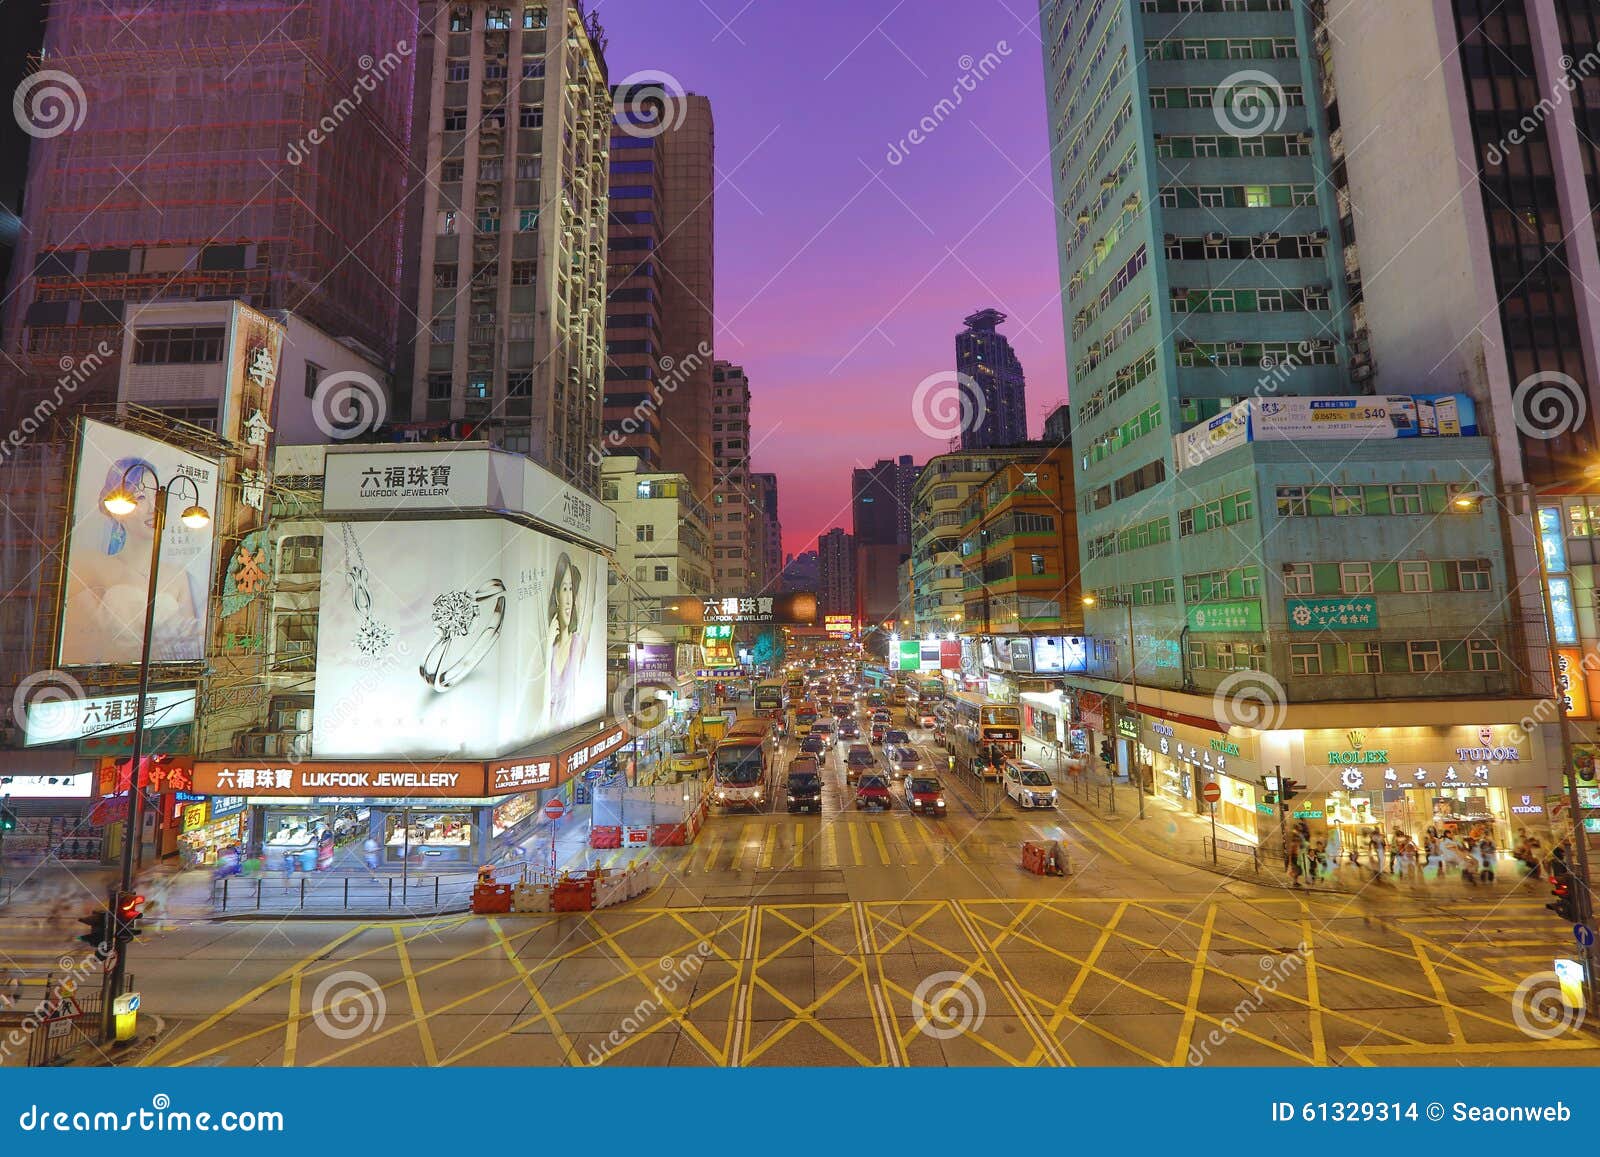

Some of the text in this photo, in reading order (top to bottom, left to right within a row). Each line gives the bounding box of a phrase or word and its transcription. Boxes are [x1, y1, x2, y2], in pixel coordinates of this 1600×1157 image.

[360, 465, 451, 488] 六福珠寶
[360, 487, 450, 498] LUKFOOK JEWELLERY
[703, 597, 774, 615] 六福珠寶
[83, 697, 158, 725] 六福珠寶
[117, 717, 156, 729] JEWEERY
[1152, 721, 1174, 737] TUDOR
[1210, 738, 1239, 757] ROLEX
[1456, 747, 1519, 761] TUDOR
[1328, 749, 1389, 765] ROLEX
[217, 768, 293, 789] 六福珠寶
[302, 772, 460, 787] LUKFOOK JEWELLERY
[495, 763, 551, 782] 六福珠寶
[495, 776, 550, 789] LUKFOOK JEWELLERY
